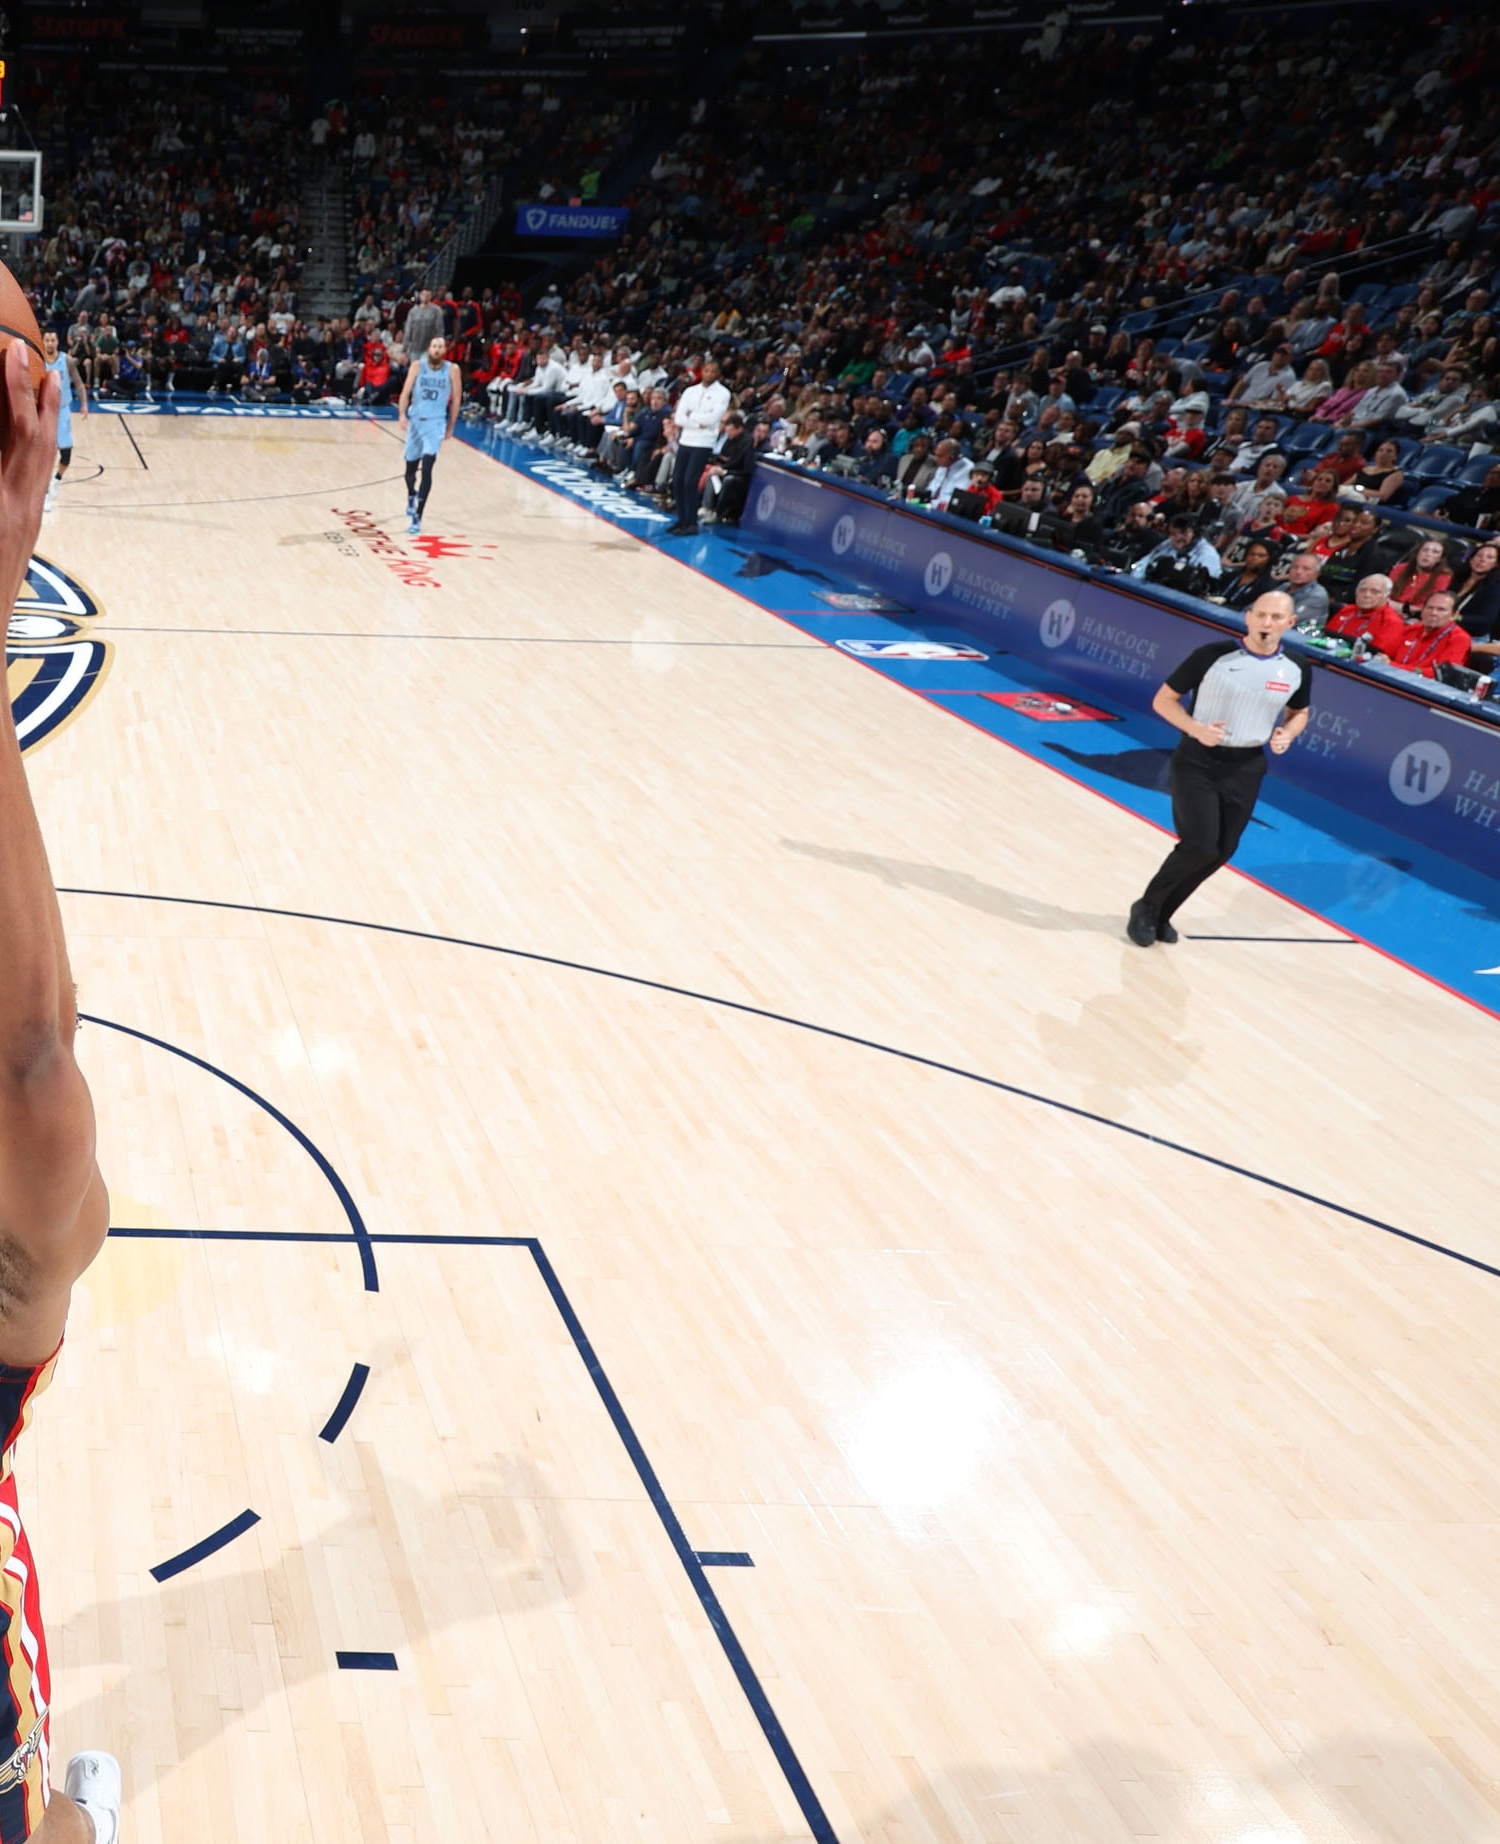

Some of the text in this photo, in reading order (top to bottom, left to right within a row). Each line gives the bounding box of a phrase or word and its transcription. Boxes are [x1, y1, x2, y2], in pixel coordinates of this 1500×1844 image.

[548, 213, 621, 230] FANDUEL
[421, 388, 439, 401] 30
[175, 405, 393, 420] FANDUEL
[1081, 617, 1160, 660] HANCOCK
